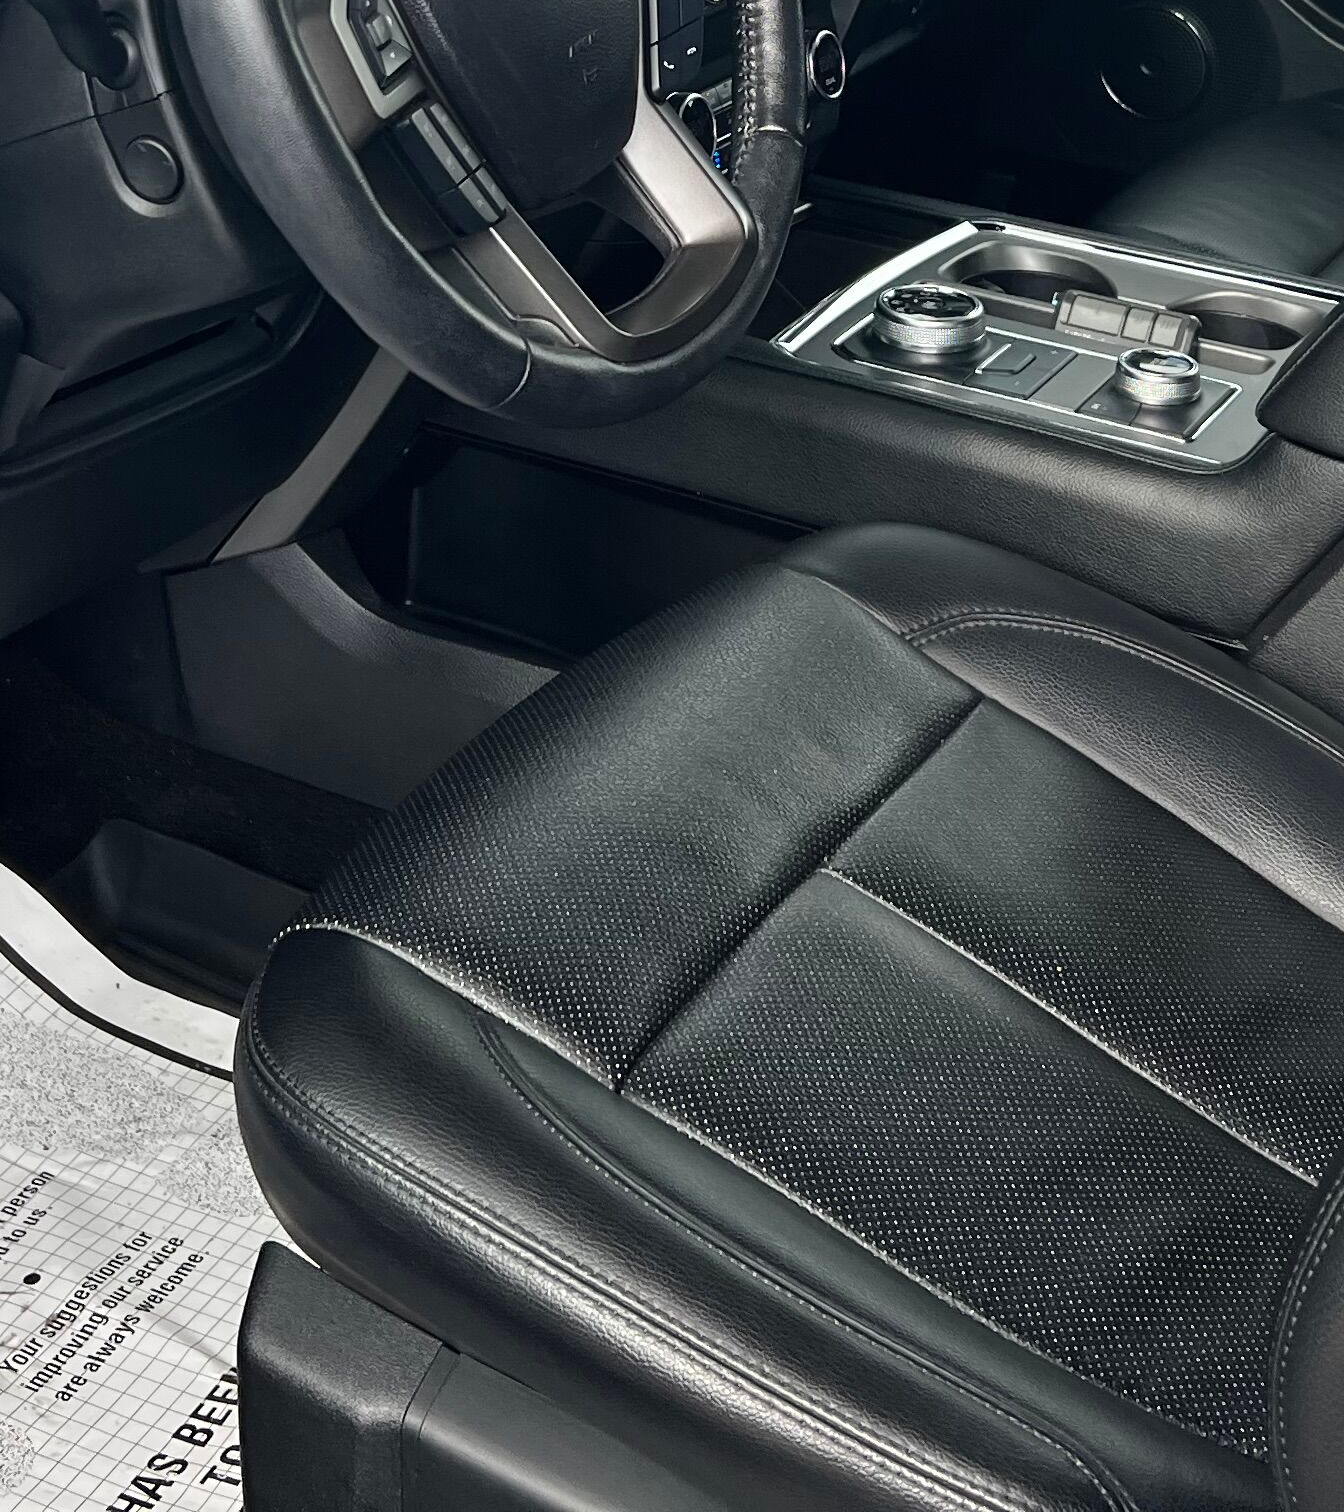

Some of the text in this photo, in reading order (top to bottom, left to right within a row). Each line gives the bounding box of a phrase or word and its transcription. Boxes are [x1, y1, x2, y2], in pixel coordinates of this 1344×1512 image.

[0, 1170, 56, 1218] person
[2, 1228, 28, 1243] to
[23, 1205, 54, 1227] us.
[19, 1237, 185, 1393] improving our service
[39, 1251, 133, 1339] suggestions
[122, 1231, 154, 1254] for
[55, 1251, 211, 1402] are always welcome.
[106, 1453, 189, 1512] HAS
